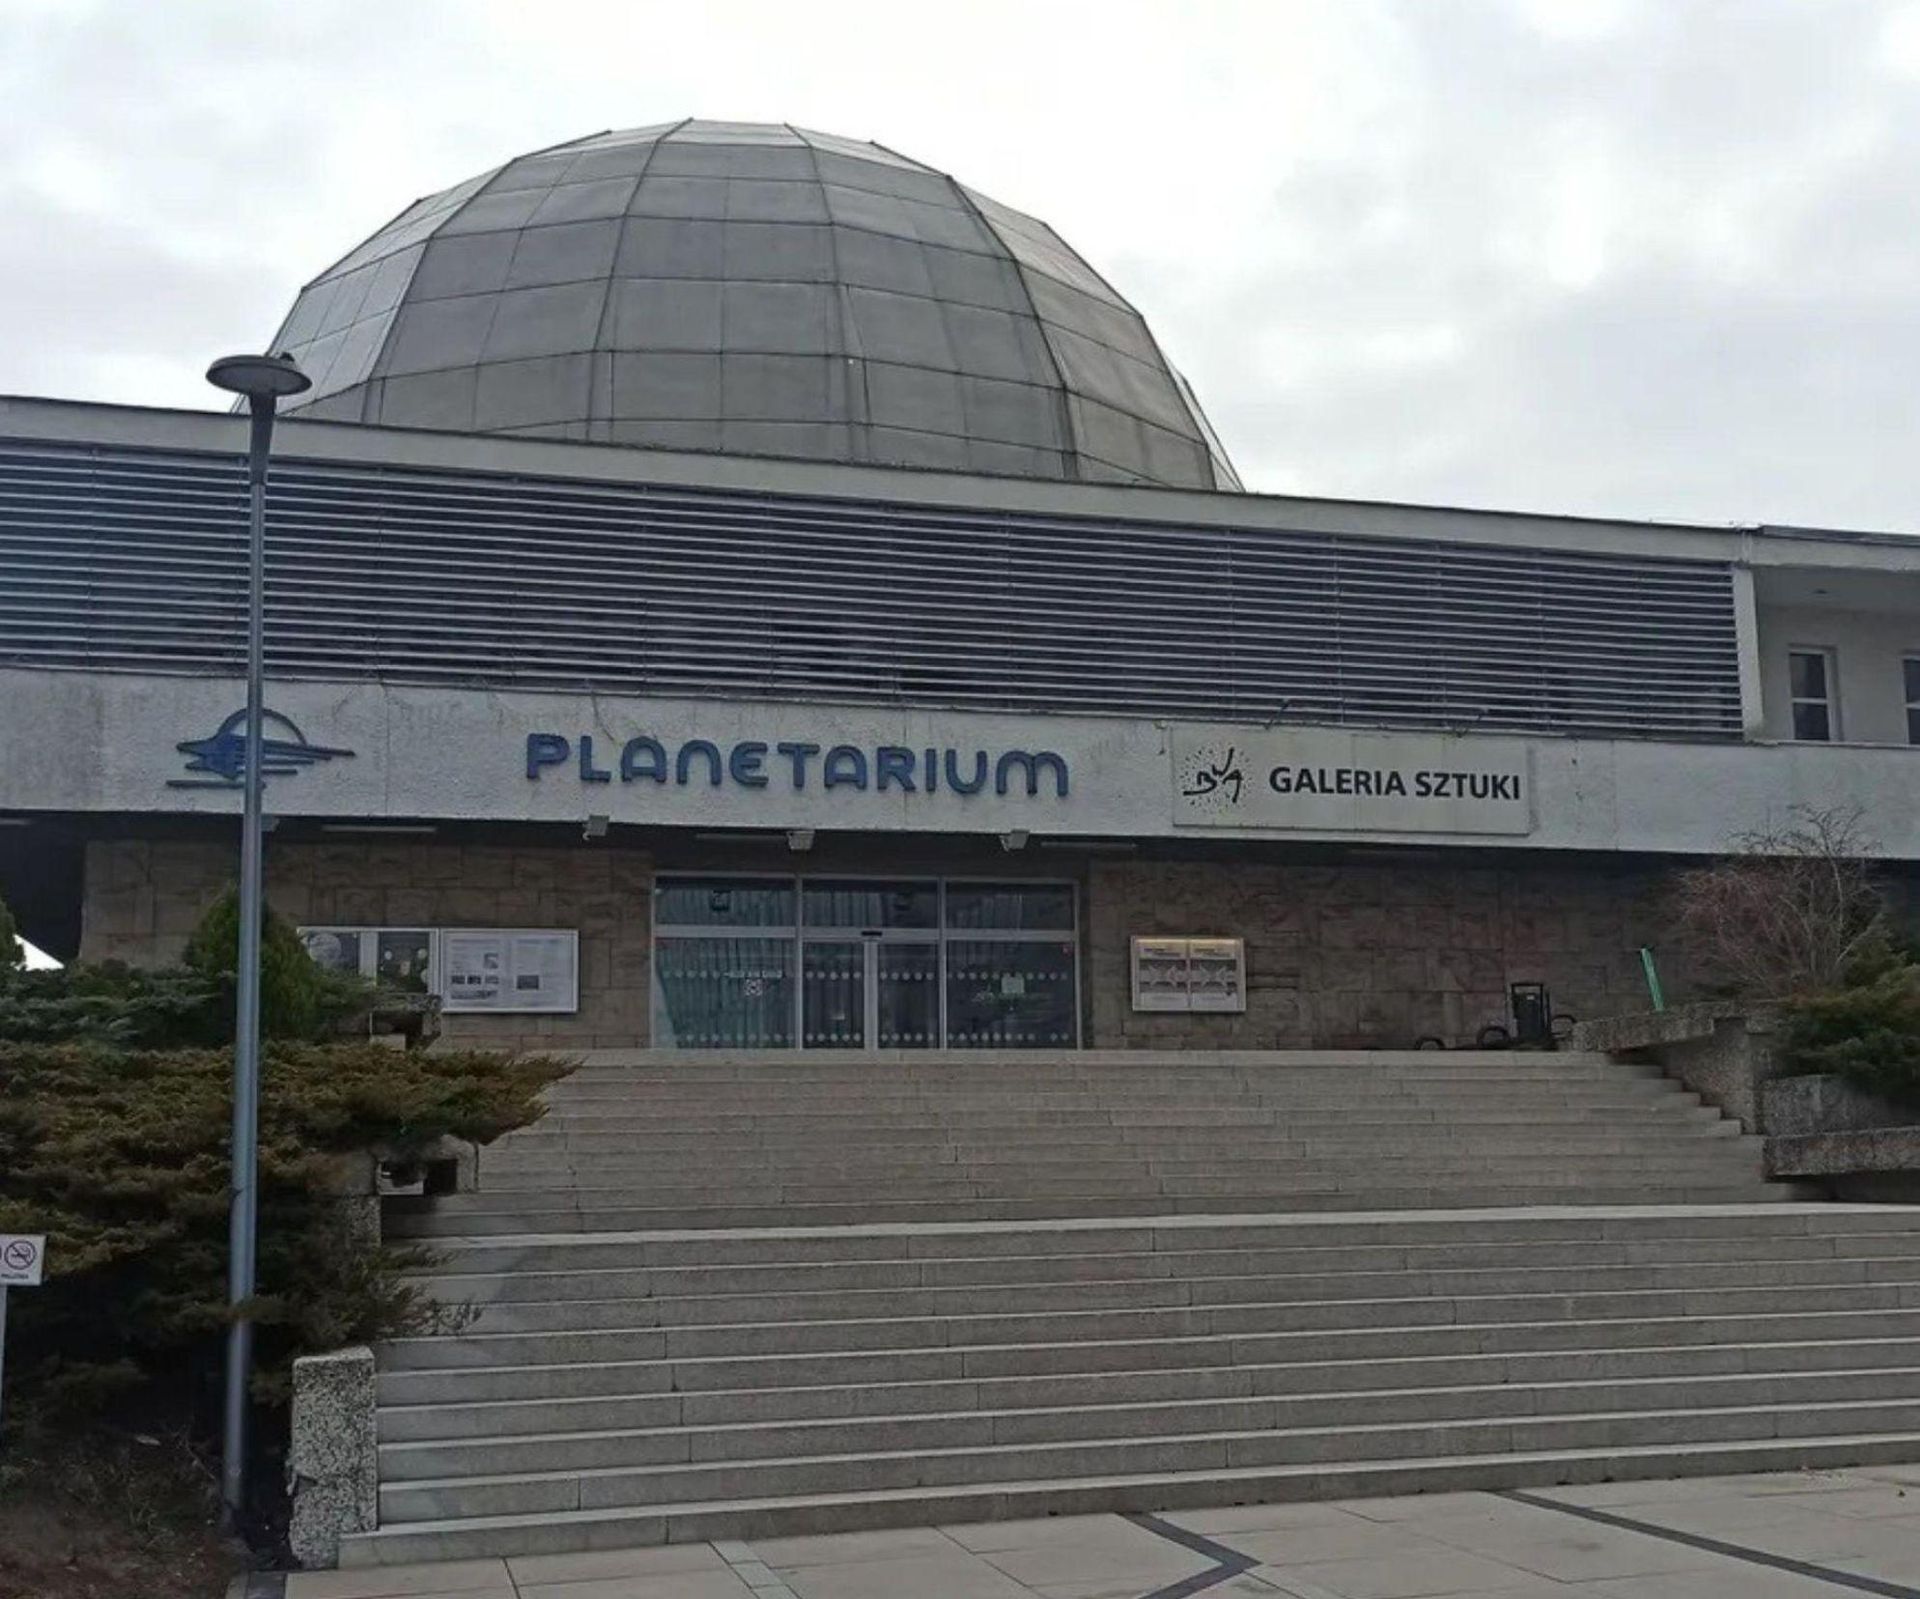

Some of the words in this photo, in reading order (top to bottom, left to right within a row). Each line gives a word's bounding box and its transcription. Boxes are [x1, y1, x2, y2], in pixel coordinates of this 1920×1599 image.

[526, 733, 1069, 797] PLANETARIUM
[1269, 766, 1406, 797] GALERIA
[1415, 772, 1521, 800] SZTUKI
